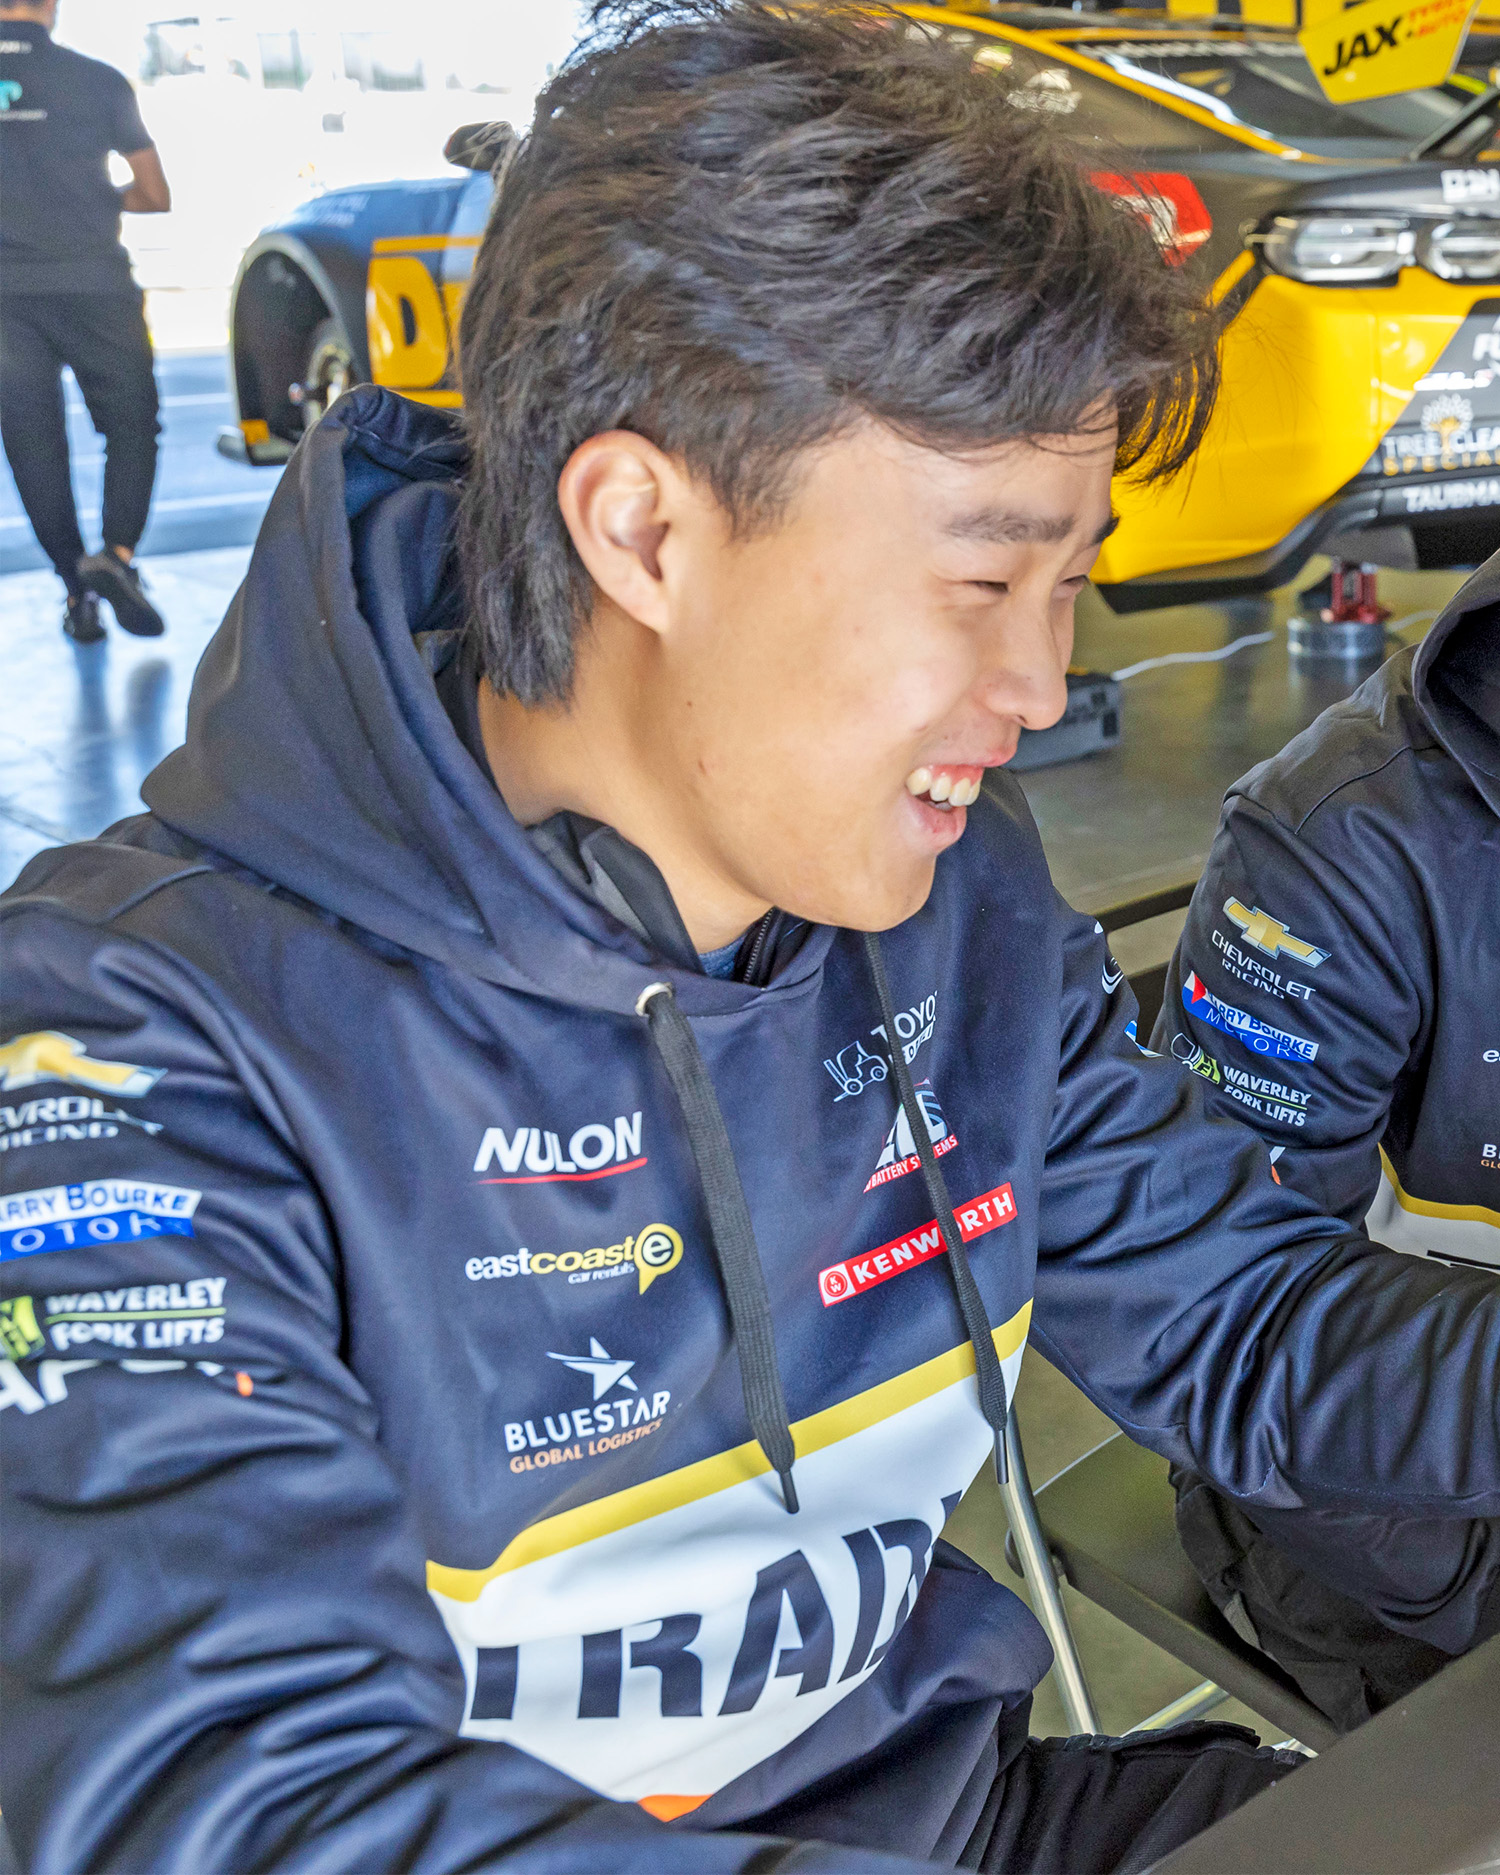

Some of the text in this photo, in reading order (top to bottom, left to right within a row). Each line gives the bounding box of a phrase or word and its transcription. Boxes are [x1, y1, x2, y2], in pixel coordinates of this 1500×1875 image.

[1324, 16, 1402, 76] JAX
[1211, 929, 1317, 1000] CHEVROLET
[1221, 957, 1285, 1000] RACING
[1223, 1064, 1312, 1106] WAVERLEY
[1223, 1085, 1307, 1127] FORK LIFTS
[473, 1111, 643, 1173] NULON
[870, 1134, 958, 1187] BATTERY SYEMS
[465, 1235, 636, 1281] eastcoast
[852, 1191, 1014, 1285] KENWRTH
[46, 1277, 227, 1314] WAVERLEY
[143, 1318, 225, 1350] LIFTS
[504, 1390, 672, 1453] BLUESTAR
[510, 1418, 663, 1474] GLOBAL LOGISTICS
